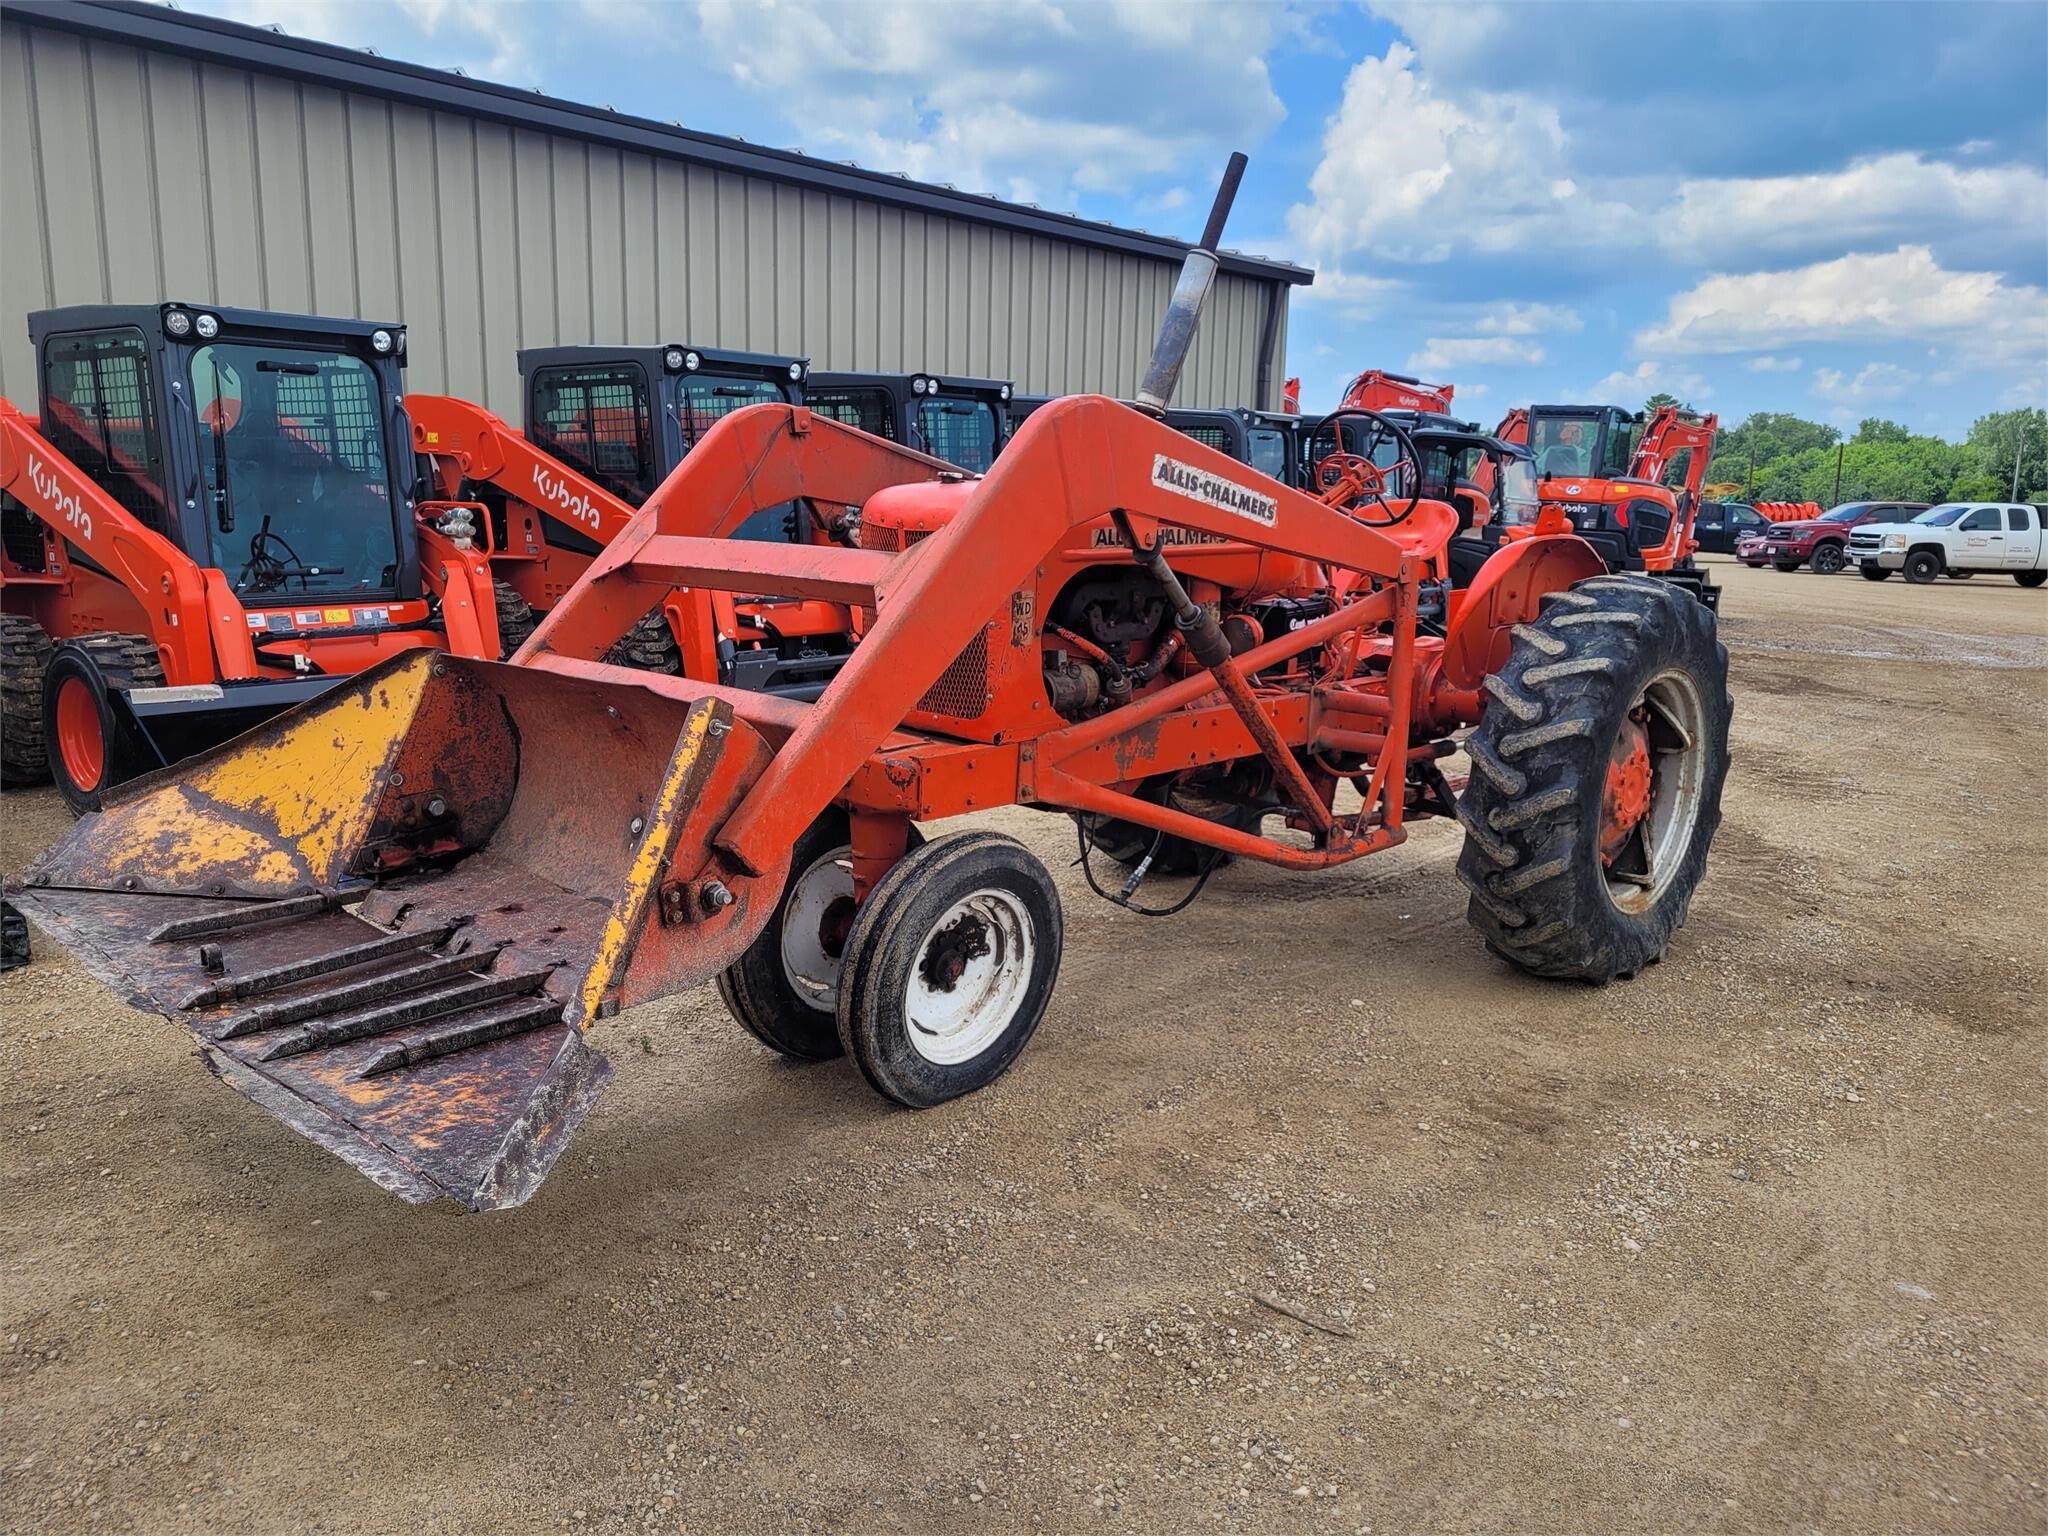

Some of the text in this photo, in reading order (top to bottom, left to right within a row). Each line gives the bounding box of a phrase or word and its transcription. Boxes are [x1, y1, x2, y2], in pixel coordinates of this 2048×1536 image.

[28, 453, 92, 540] Kubota
[533, 463, 600, 530] Kubota
[1157, 463, 1275, 521] ALLIS-CHALMERS
[1015, 602, 1031, 615] WD
